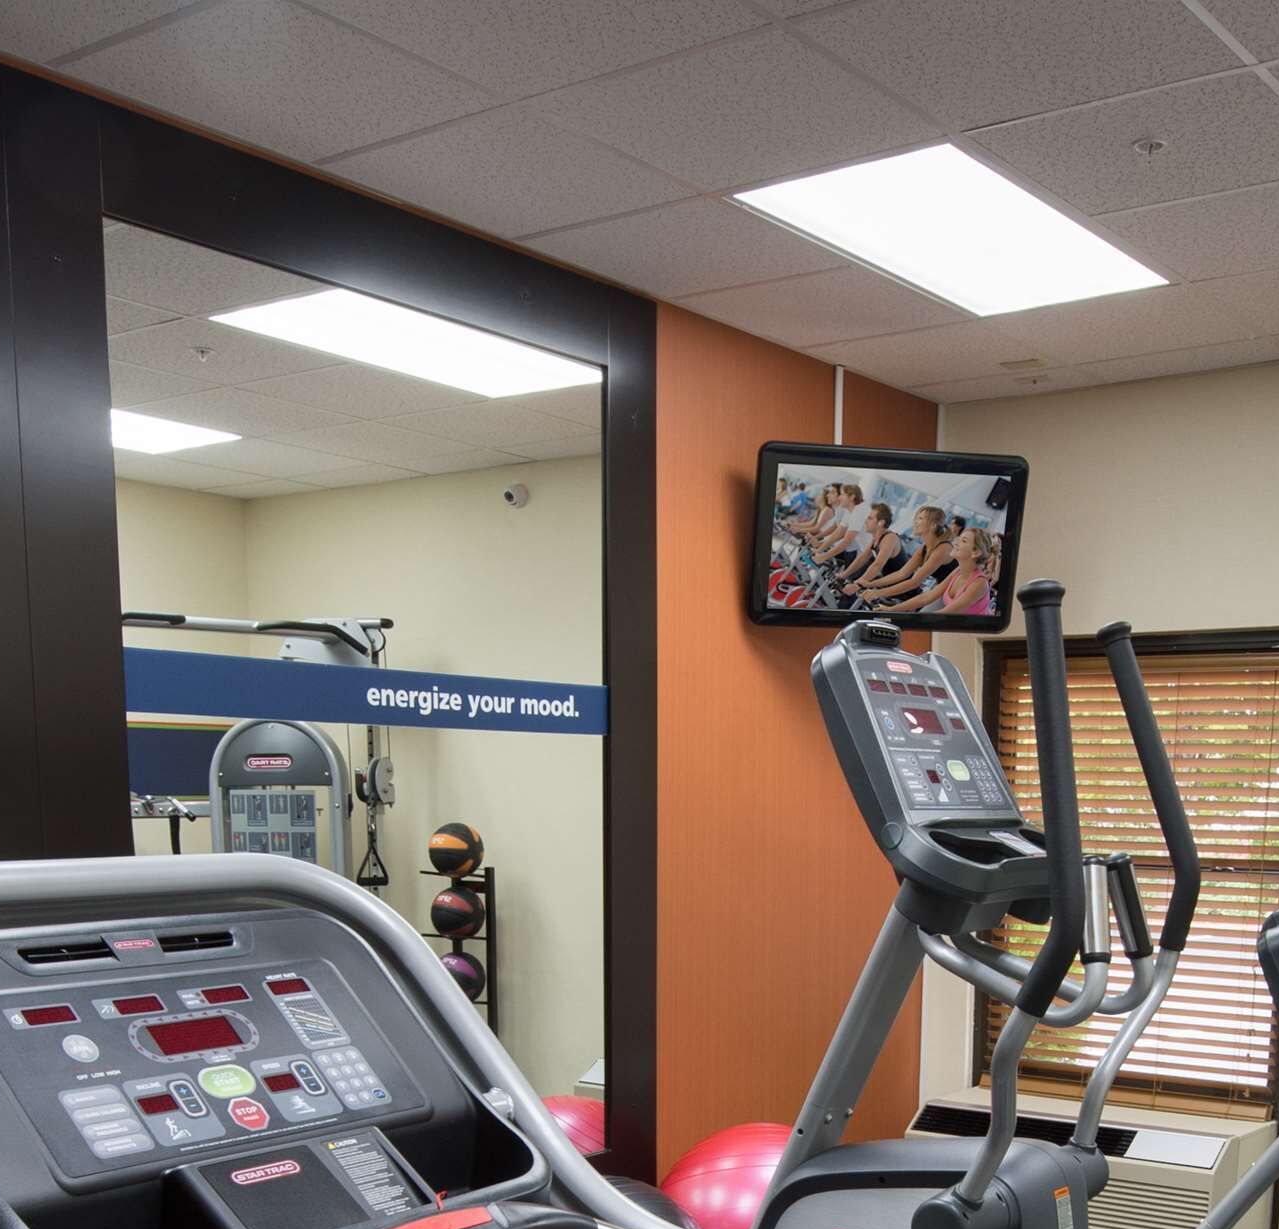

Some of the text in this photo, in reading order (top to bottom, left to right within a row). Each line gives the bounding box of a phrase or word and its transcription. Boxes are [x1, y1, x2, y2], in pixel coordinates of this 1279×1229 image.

[366, 686, 580, 718] energize your mood.
[235, 1106, 258, 1116] STOP
[237, 1163, 295, 1182] STAR TRAC
